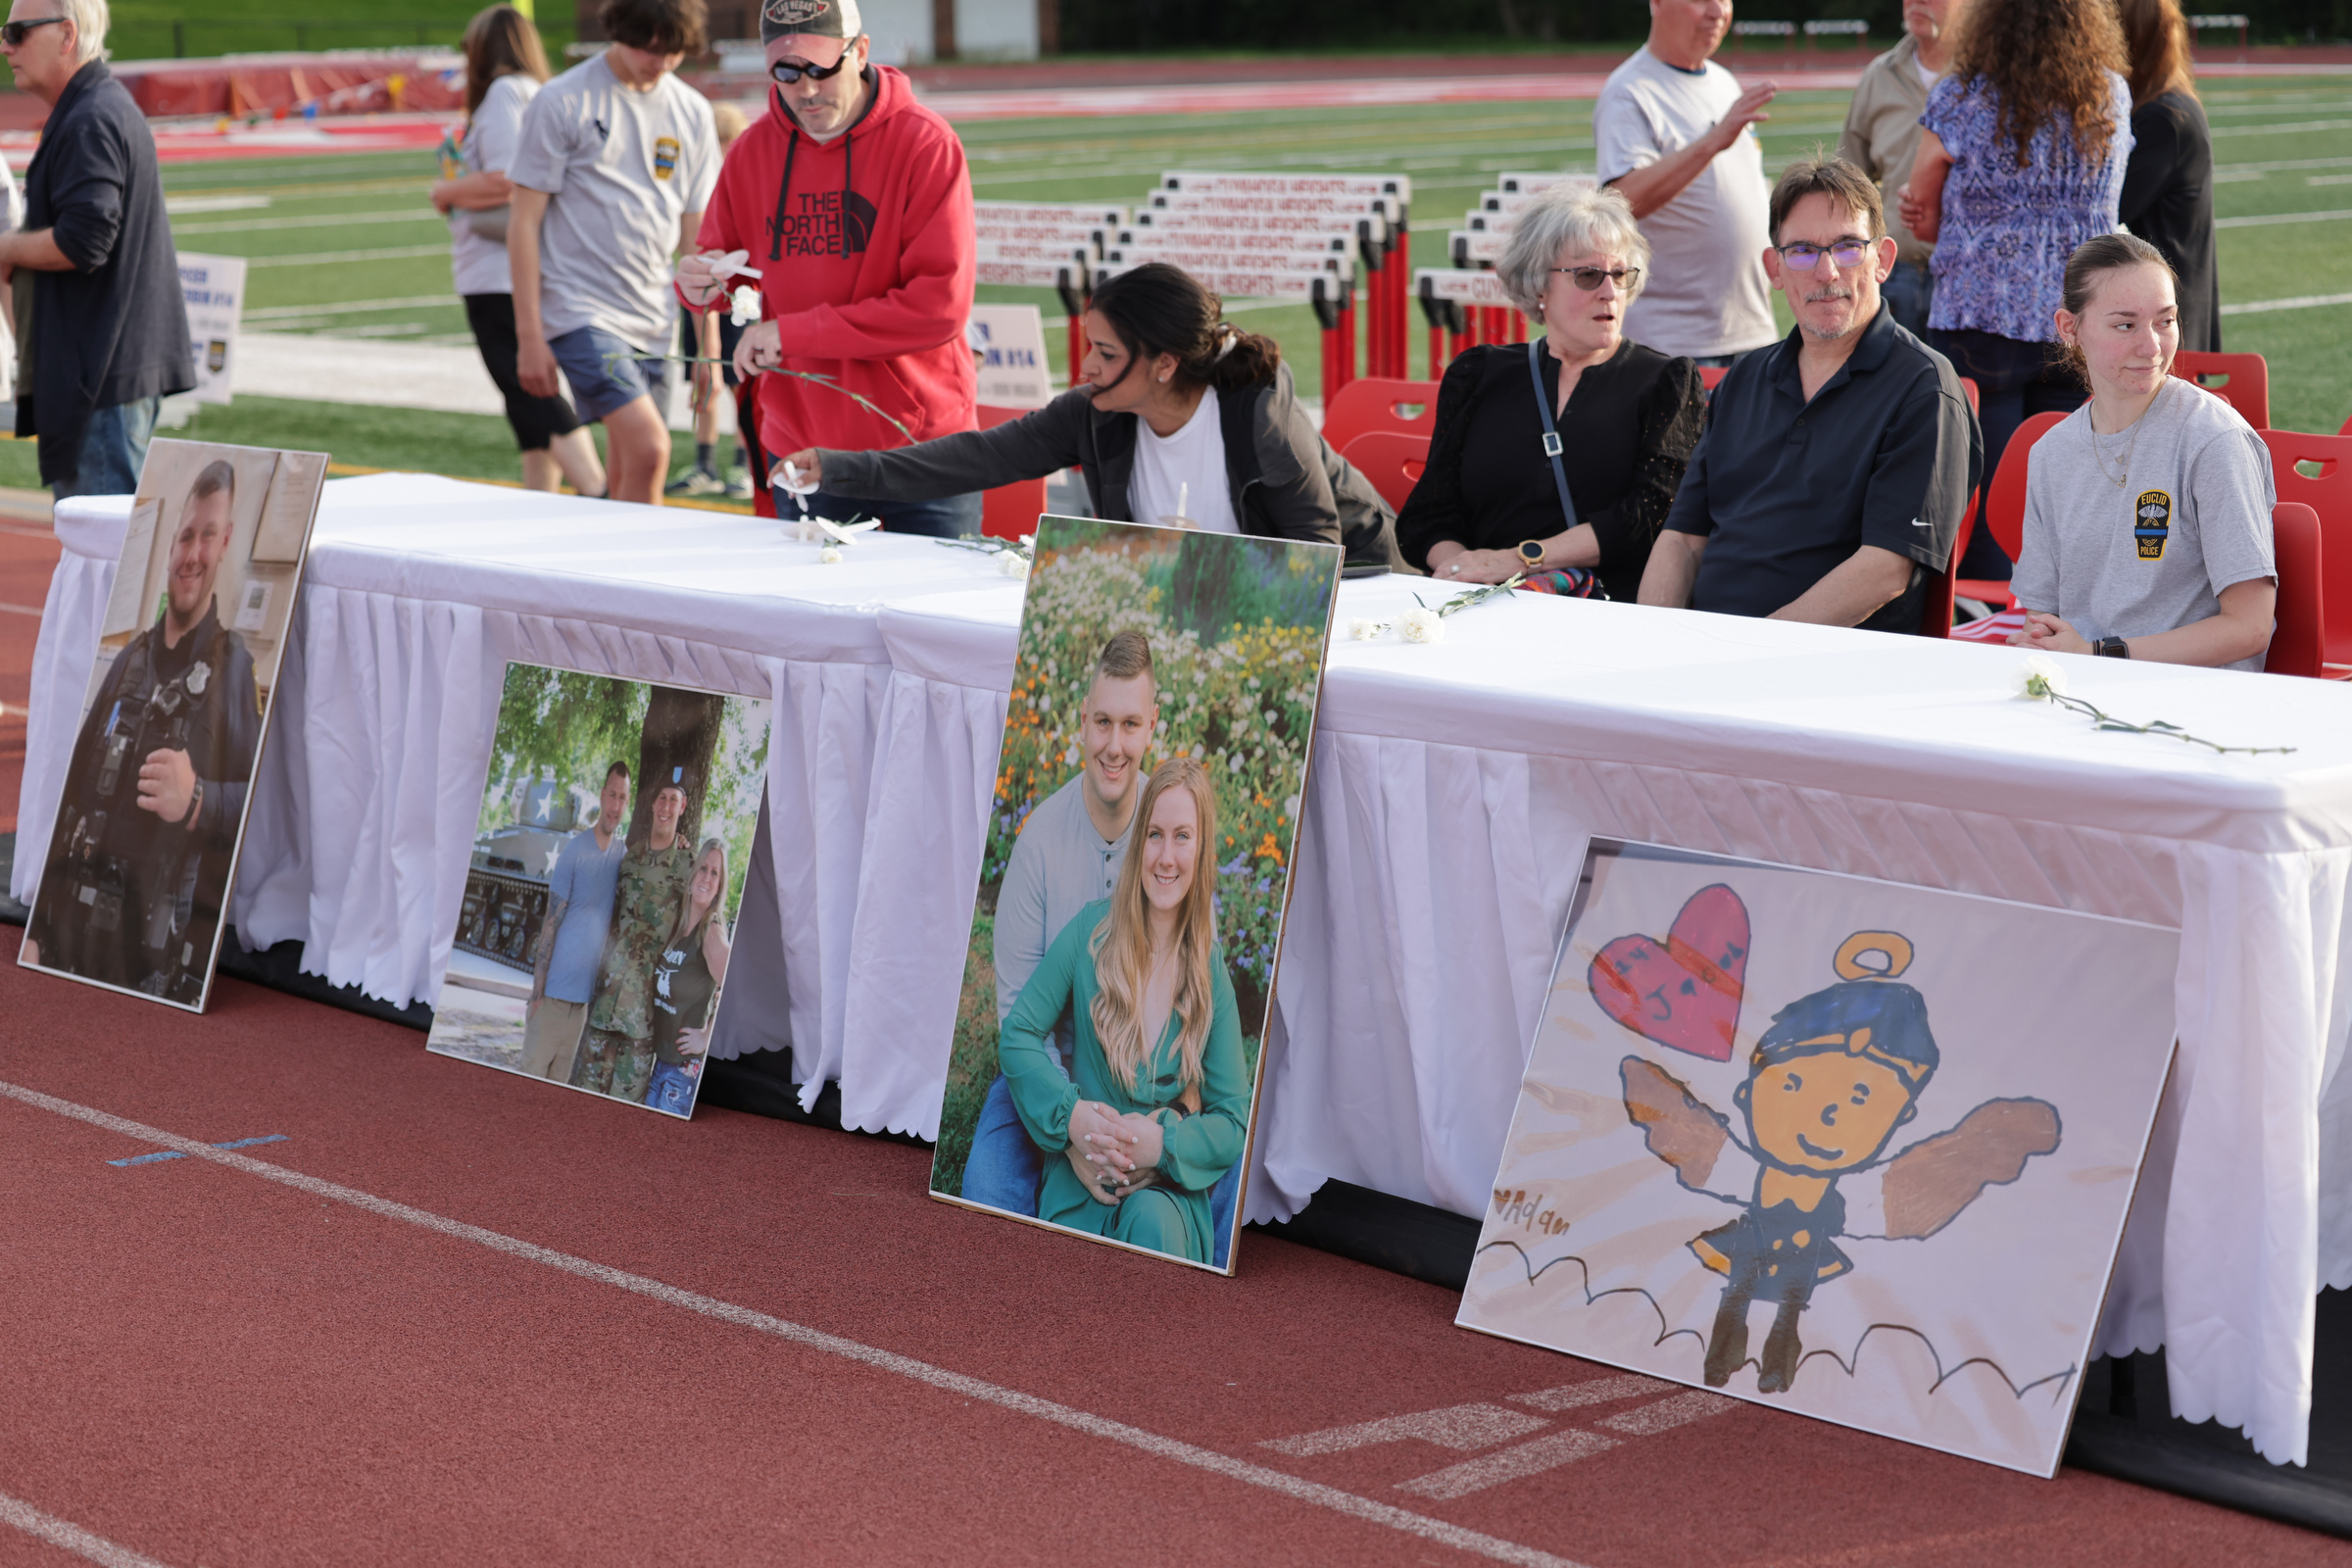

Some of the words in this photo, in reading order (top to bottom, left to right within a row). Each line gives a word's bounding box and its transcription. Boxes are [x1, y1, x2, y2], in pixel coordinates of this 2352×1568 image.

[776, 1, 789, 15] LAS
[789, 0, 813, 13] VEGAS
[798, 191, 839, 213] THE
[765, 213, 840, 236] NORTH
[786, 234, 841, 257] FACE
[1219, 274, 1276, 296] HEIGHTS
[2141, 493, 2168, 506] EUCLID
[2140, 546, 2159, 556] POLICE
